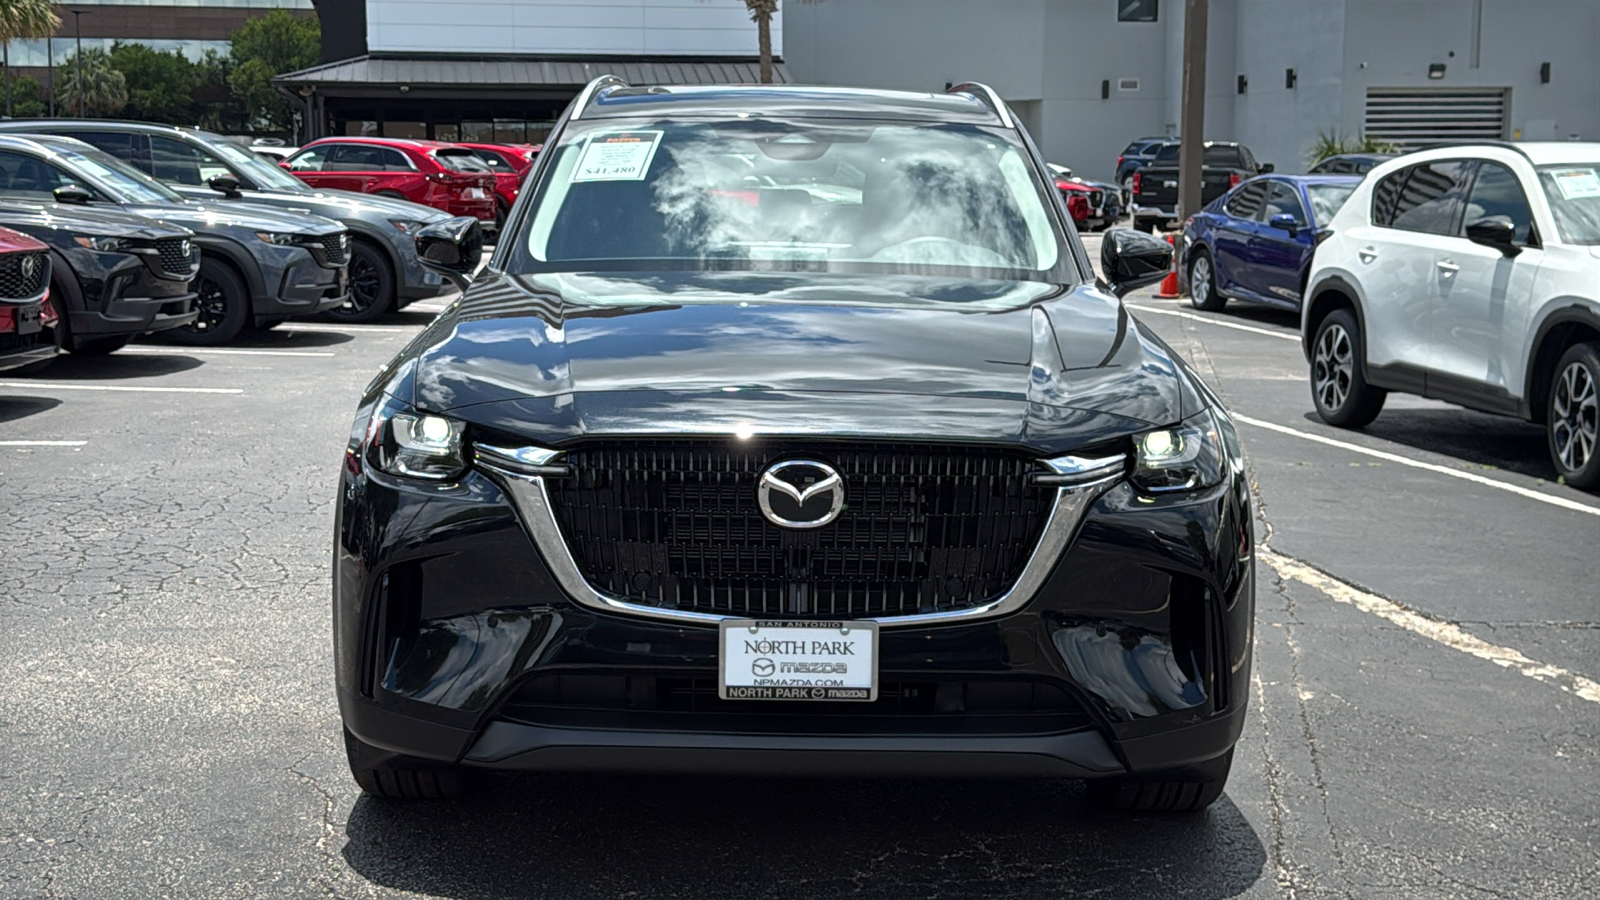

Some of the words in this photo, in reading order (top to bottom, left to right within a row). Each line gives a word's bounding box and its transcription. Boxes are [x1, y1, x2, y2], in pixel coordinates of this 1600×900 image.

[586, 166, 636, 175] $41,480
[744, 639, 806, 655] NORTH
[811, 641, 855, 655] PARK
[780, 661, 848, 674] mazda
[753, 678, 844, 687] NPMAZDA.COM
[729, 687, 772, 698] NORTH
[776, 688, 808, 698] PARK
[827, 689, 868, 698] mazda
